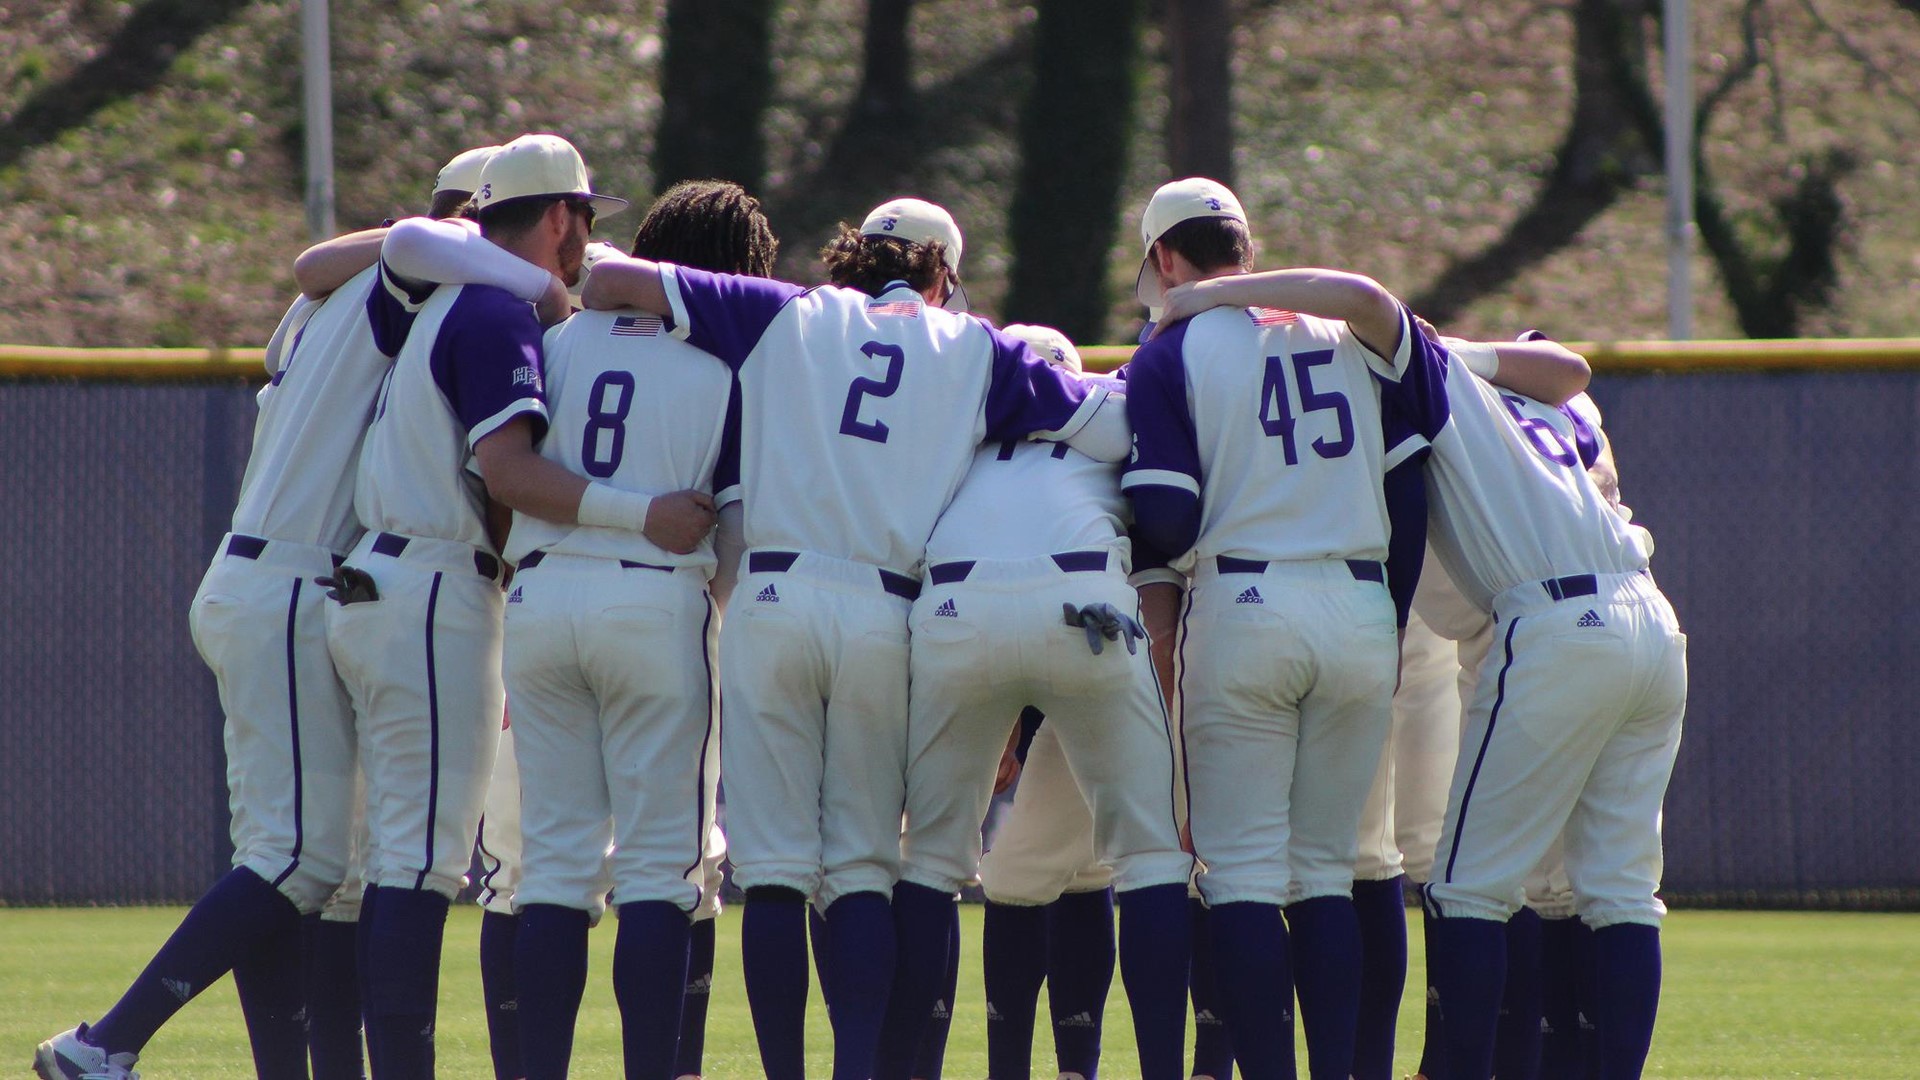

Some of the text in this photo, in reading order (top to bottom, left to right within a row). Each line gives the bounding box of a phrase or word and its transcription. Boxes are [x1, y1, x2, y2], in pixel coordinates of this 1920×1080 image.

[582, 370, 635, 478] 8
[839, 341, 905, 443] 2
[1259, 349, 1355, 465] 45
[1500, 394, 1577, 467] 6
